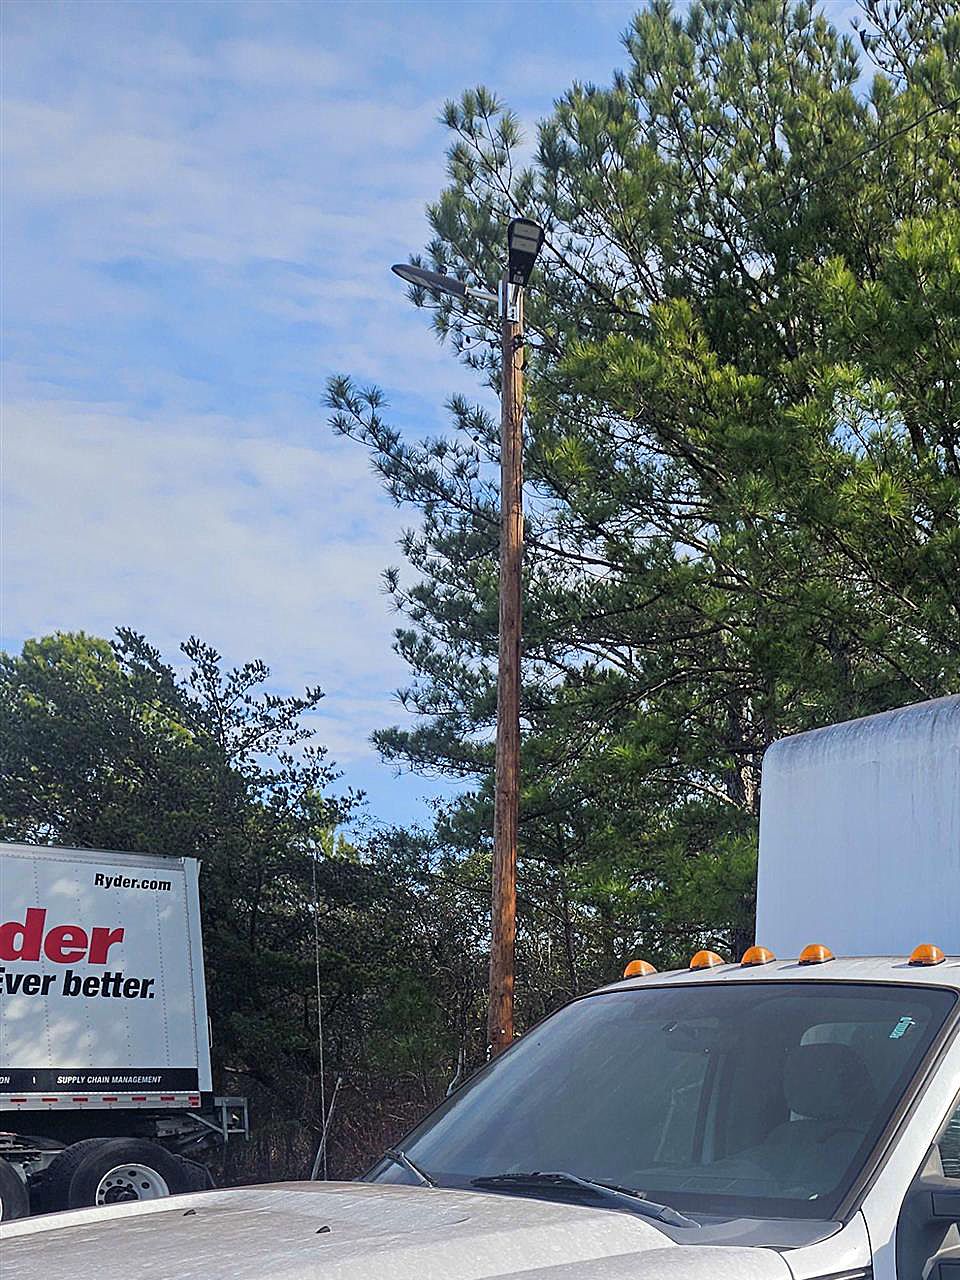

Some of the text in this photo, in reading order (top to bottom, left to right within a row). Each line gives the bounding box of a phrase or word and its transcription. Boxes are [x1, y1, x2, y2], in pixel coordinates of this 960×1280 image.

[94, 873, 172, 891] Ryder.com
[62, 970, 155, 999] better.
[57, 1076, 86, 1084] SUPPLY
[86, 1076, 110, 1084] CHAIN
[111, 1076, 162, 1084] MANAGEMENT
